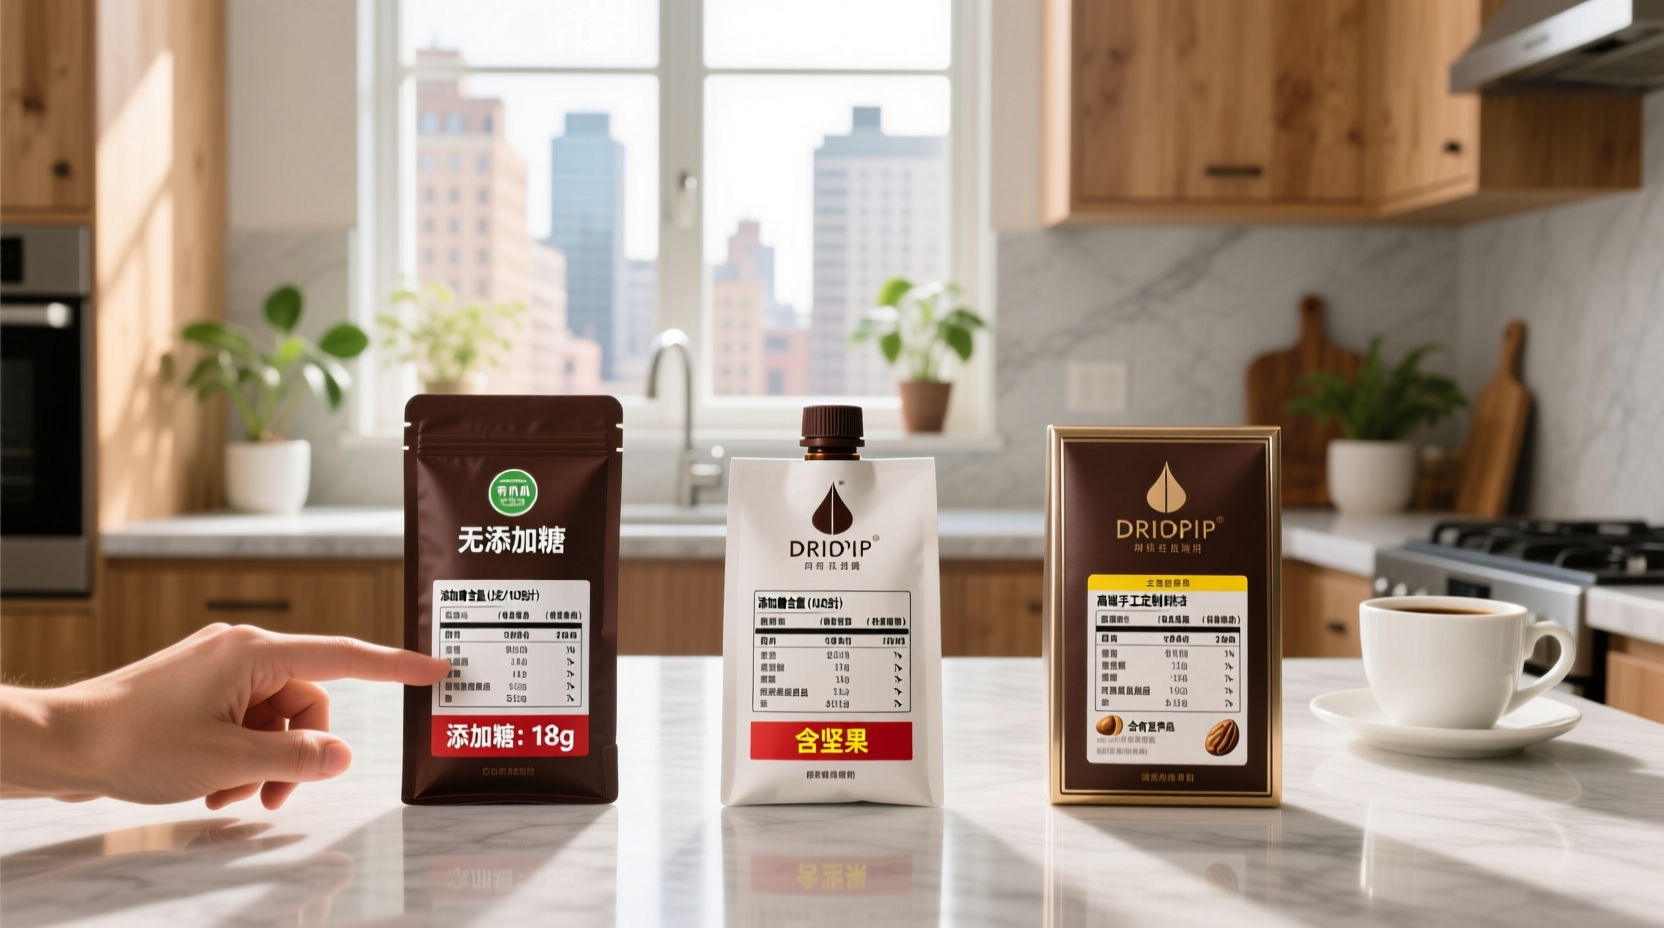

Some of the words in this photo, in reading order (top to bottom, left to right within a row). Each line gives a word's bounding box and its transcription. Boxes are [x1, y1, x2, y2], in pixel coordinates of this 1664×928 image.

[458, 526, 566, 554] 无添加糖
[532, 724, 575, 752] 18g
[795, 727, 869, 753] 含坚果
